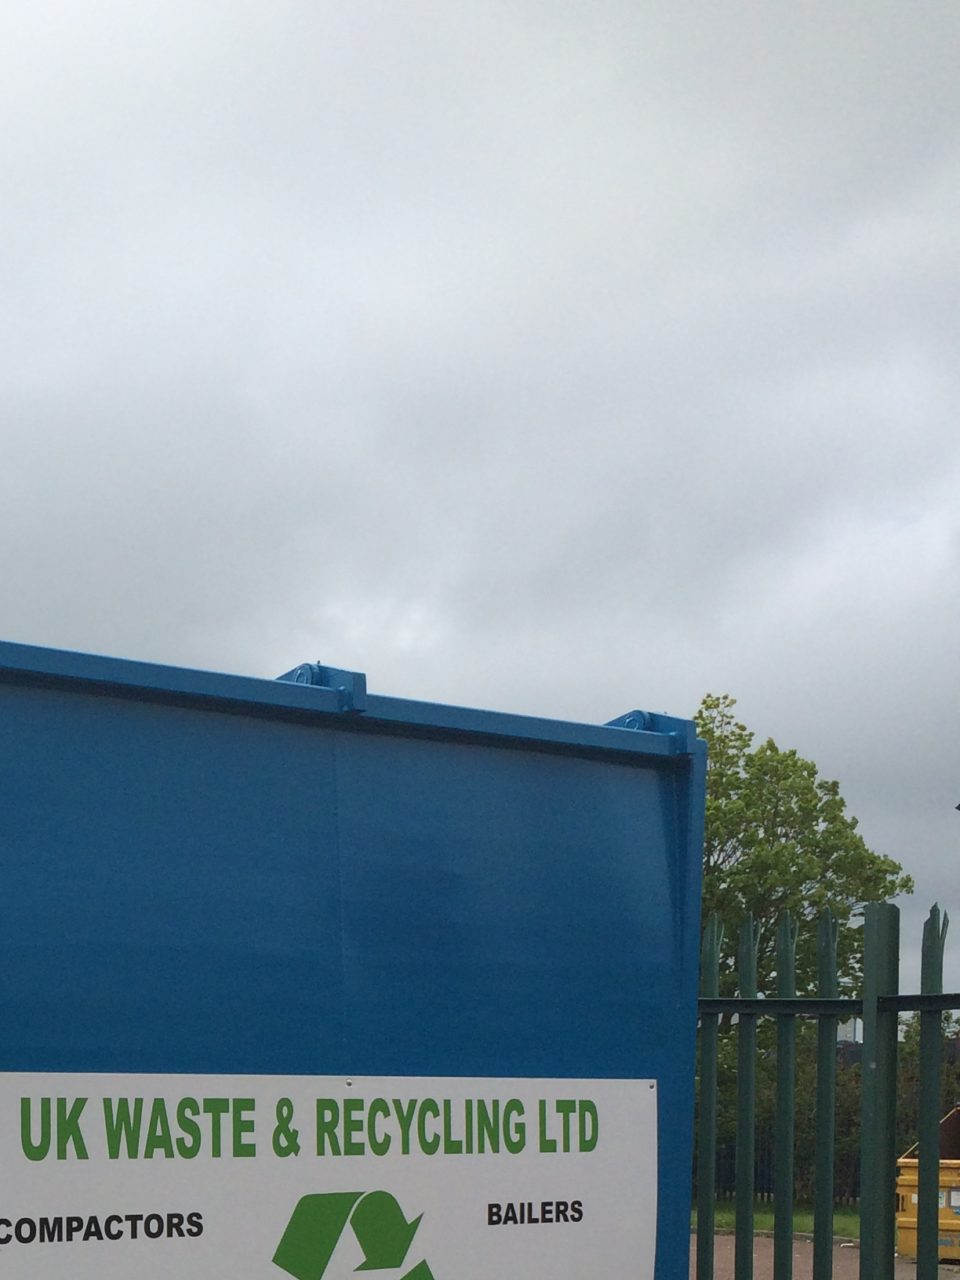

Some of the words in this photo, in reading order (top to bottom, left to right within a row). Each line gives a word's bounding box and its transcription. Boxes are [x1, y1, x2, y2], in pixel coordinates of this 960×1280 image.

[21, 1097, 89, 1161] UK
[103, 1097, 256, 1160] WASTE
[272, 1097, 301, 1158] &
[316, 1097, 526, 1156] RECYCLING
[539, 1099, 599, 1153] LTD
[487, 1200, 584, 1226] BAILERS
